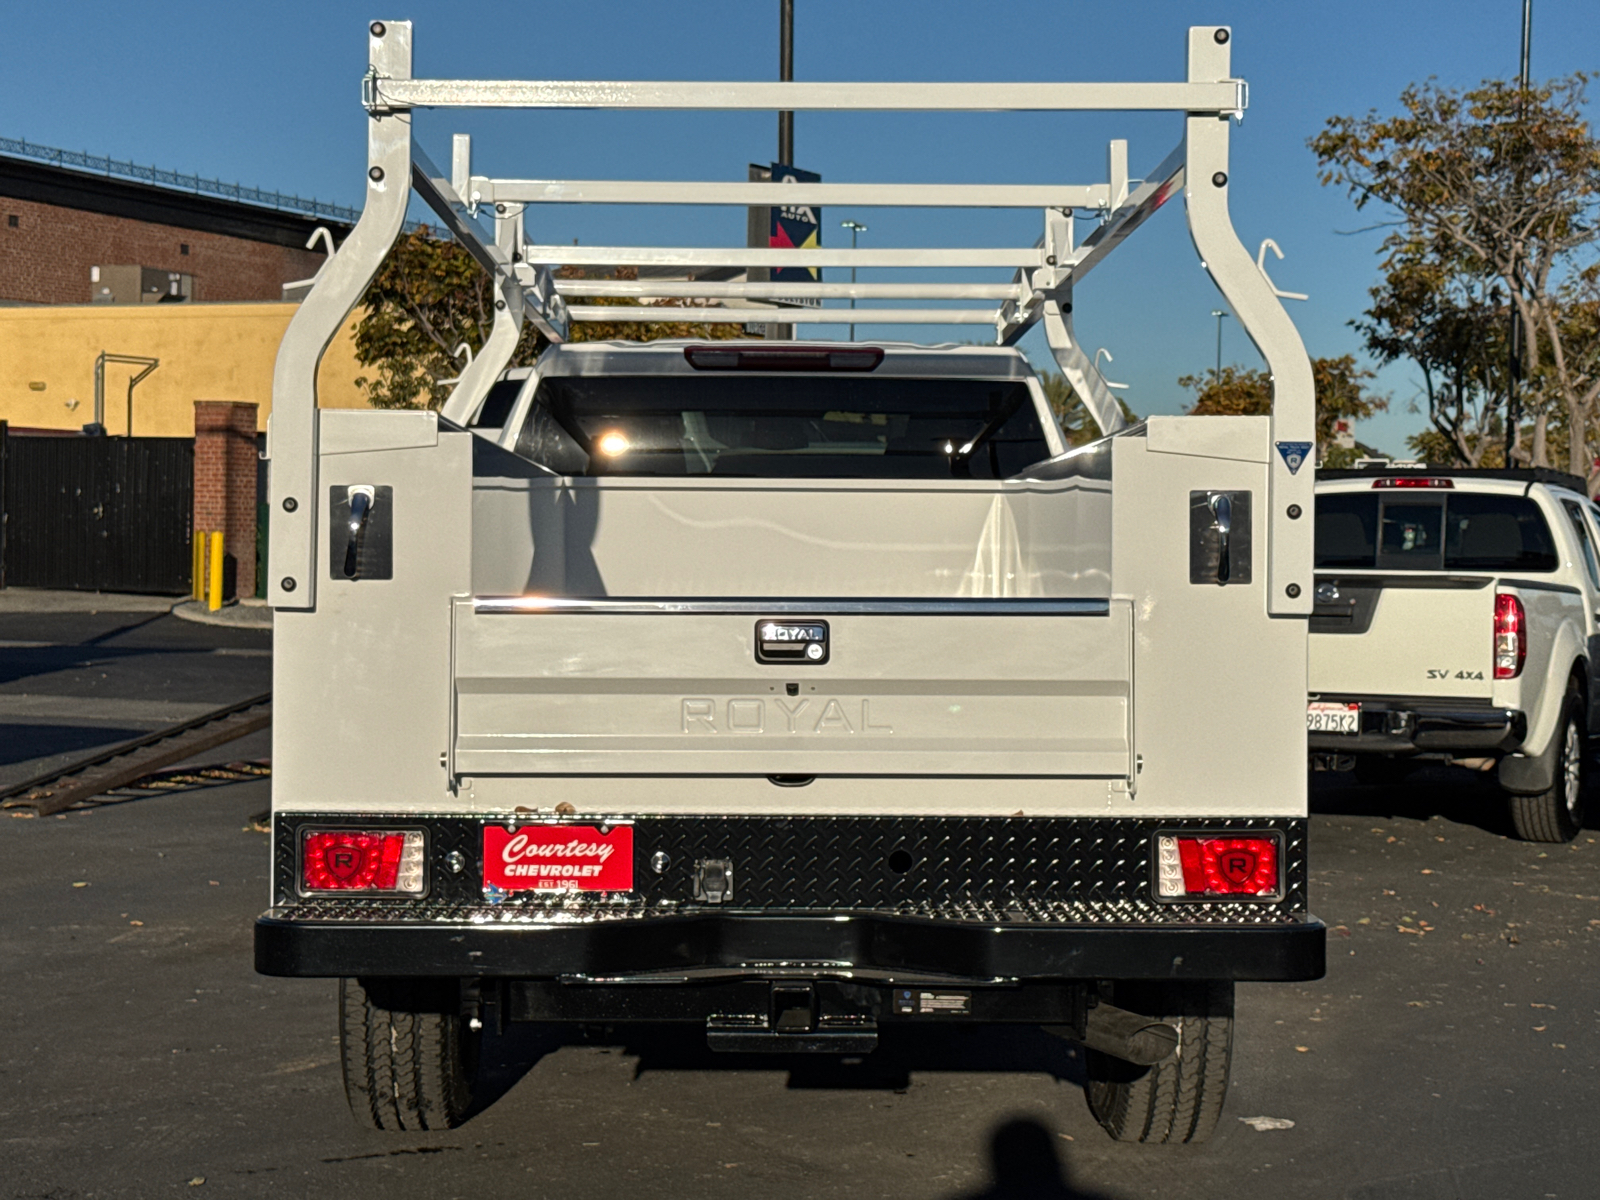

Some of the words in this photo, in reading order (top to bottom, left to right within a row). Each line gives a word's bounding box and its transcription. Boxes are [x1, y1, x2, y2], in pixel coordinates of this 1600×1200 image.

[780, 211, 809, 223] AUTO
[762, 628, 819, 640] ROYAL
[1426, 669, 1450, 679] SV
[681, 698, 893, 733] ROYAL
[501, 834, 615, 863] Courtesy
[335, 852, 353, 868] R
[1229, 858, 1247, 873] R
[503, 864, 603, 876] CHEVROLET
[556, 880, 579, 888] 1961
